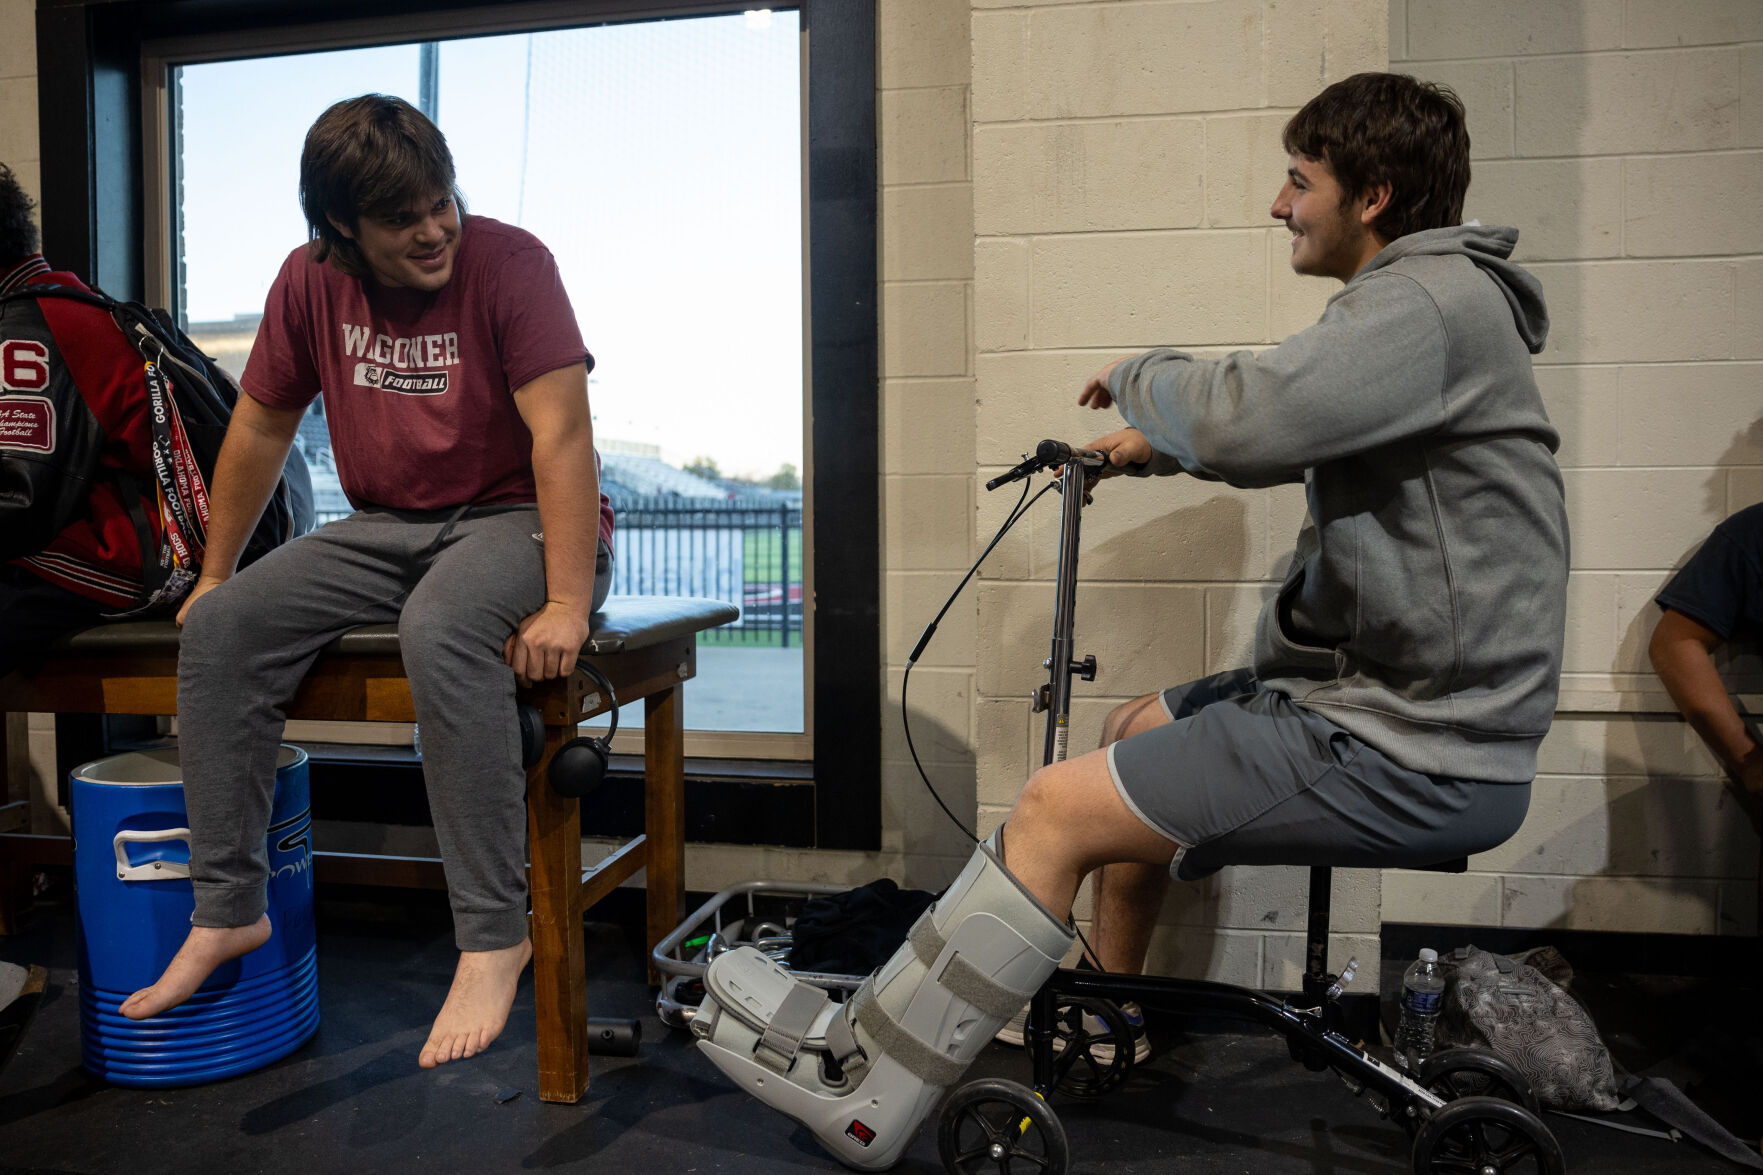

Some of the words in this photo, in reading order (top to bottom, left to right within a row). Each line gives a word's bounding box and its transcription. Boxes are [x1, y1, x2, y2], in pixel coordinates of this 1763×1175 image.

[342, 323, 460, 369] WGONER
[0, 419, 39, 429] hampions
[12, 409, 37, 419] State
[150, 380, 166, 424] GORILLA
[152, 441, 171, 486] GORILLA
[173, 449, 190, 497] OKLAHOMA
[170, 532, 188, 557] HOGS
